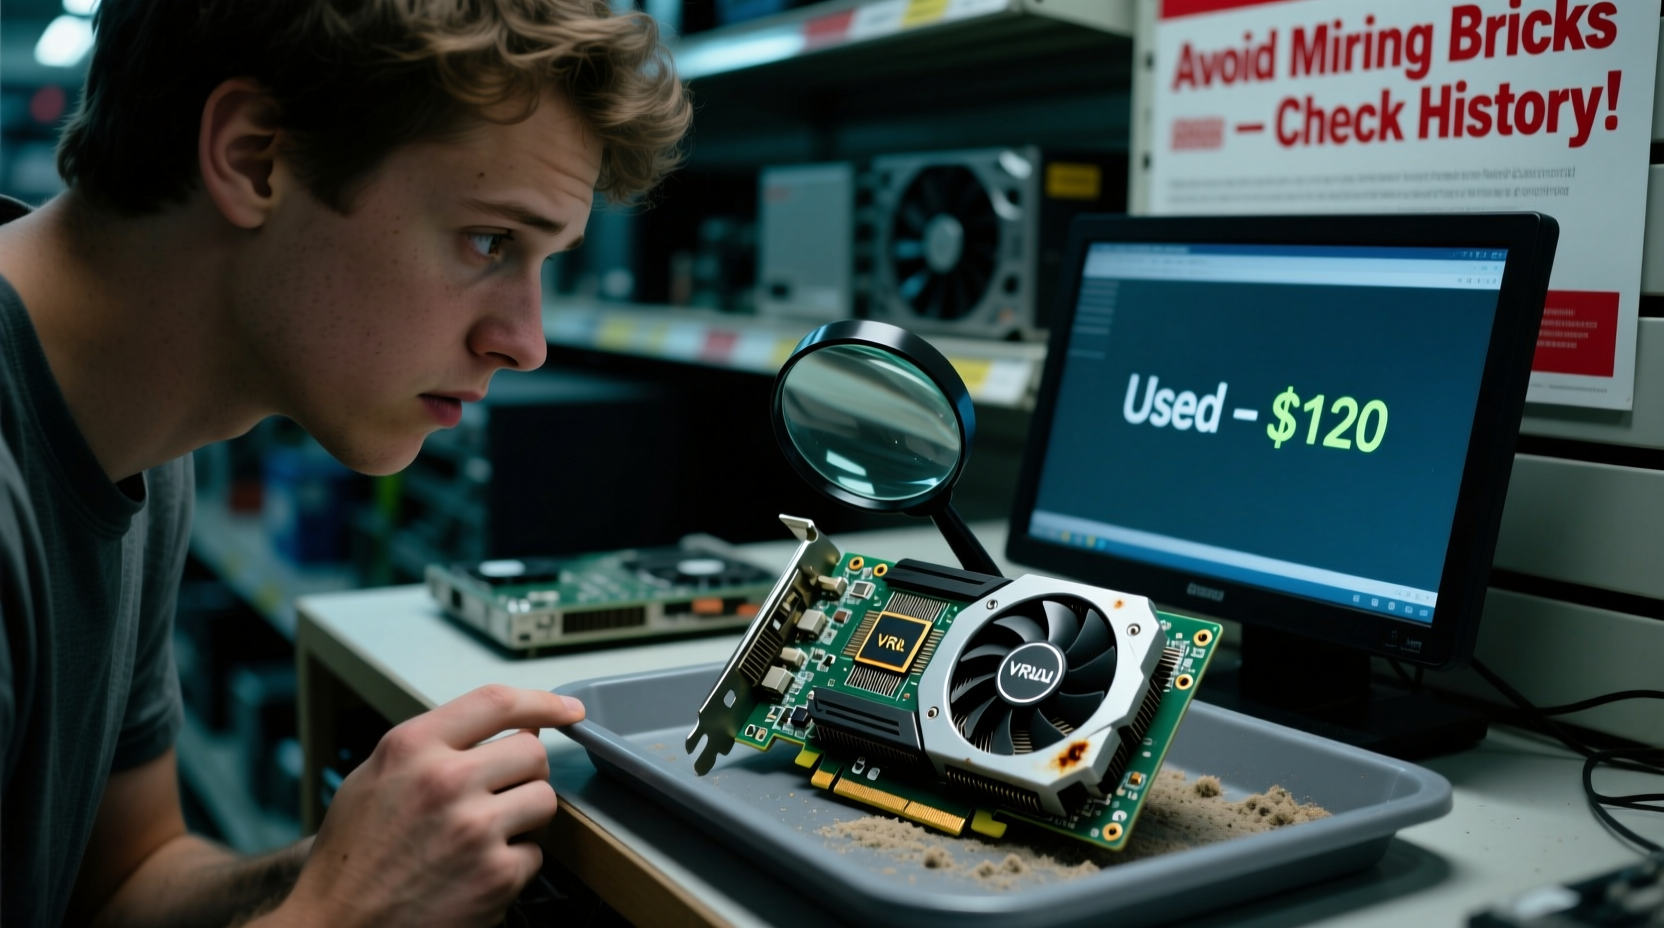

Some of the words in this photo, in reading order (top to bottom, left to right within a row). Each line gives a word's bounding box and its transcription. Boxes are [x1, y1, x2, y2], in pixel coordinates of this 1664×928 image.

[1172, 29, 1278, 92] Avoid
[1289, 15, 1434, 81] Miring
[1448, 0, 1618, 63] Bricks
[1274, 89, 1405, 149] Check
[1417, 70, 1622, 149] History!
[1122, 372, 1229, 434] Used
[1265, 385, 1389, 453] $120
